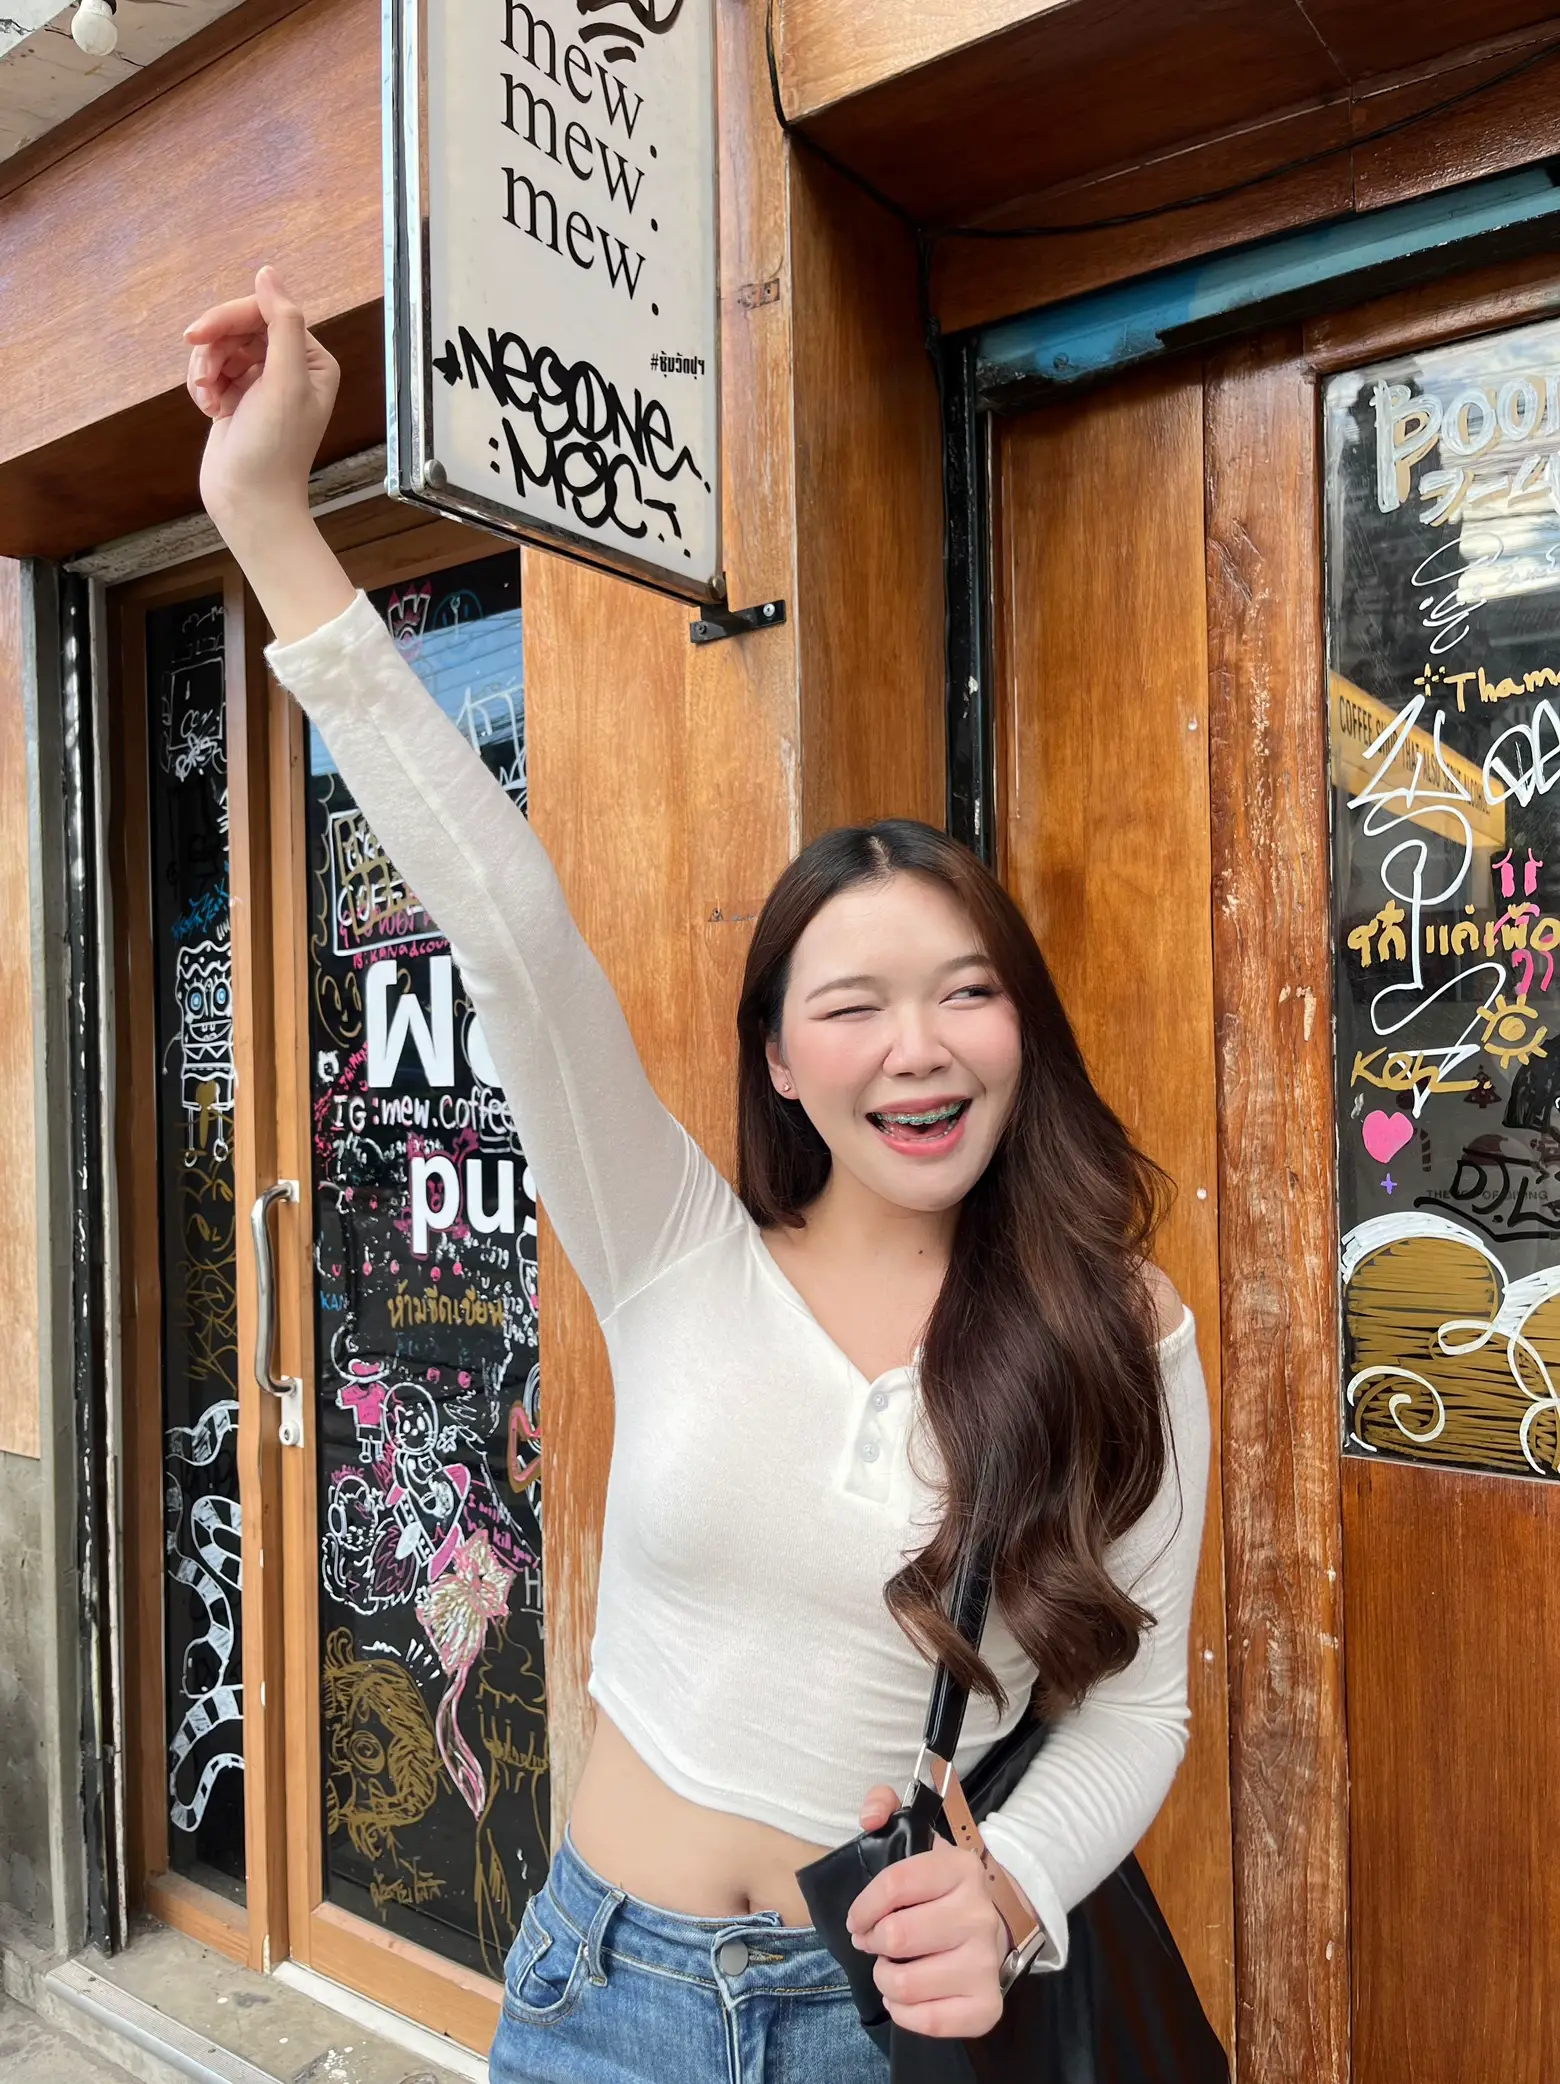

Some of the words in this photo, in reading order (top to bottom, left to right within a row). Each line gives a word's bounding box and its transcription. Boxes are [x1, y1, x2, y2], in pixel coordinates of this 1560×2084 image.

[500, 73, 658, 231] mew.
[501, 167, 659, 316] mew.
[1339, 695, 1373, 746] COFFEE
[1426, 1189, 1450, 1199] THE
[1507, 1189, 1548, 1200] GIING
